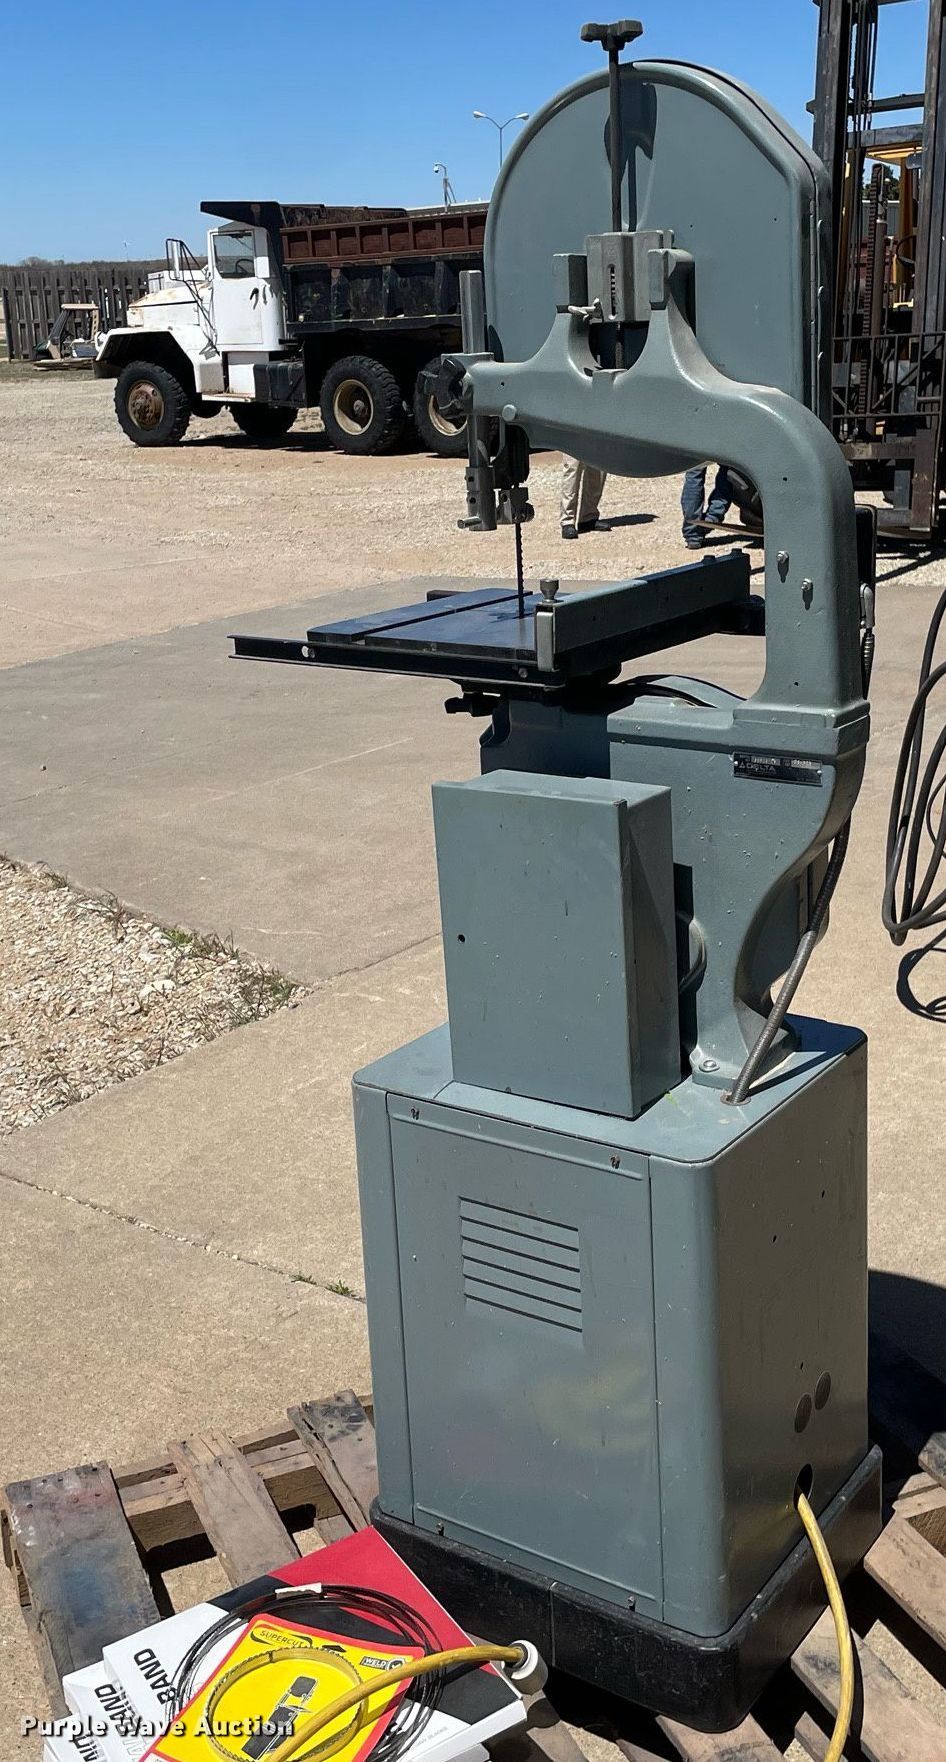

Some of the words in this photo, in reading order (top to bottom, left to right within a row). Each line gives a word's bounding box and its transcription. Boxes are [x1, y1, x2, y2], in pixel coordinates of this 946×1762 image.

[746, 763, 776, 772] DELTA
[259, 1630, 305, 1647] SUPERCUT
[365, 1658, 387, 1668] WELD
[133, 1648, 177, 1704] BAND
